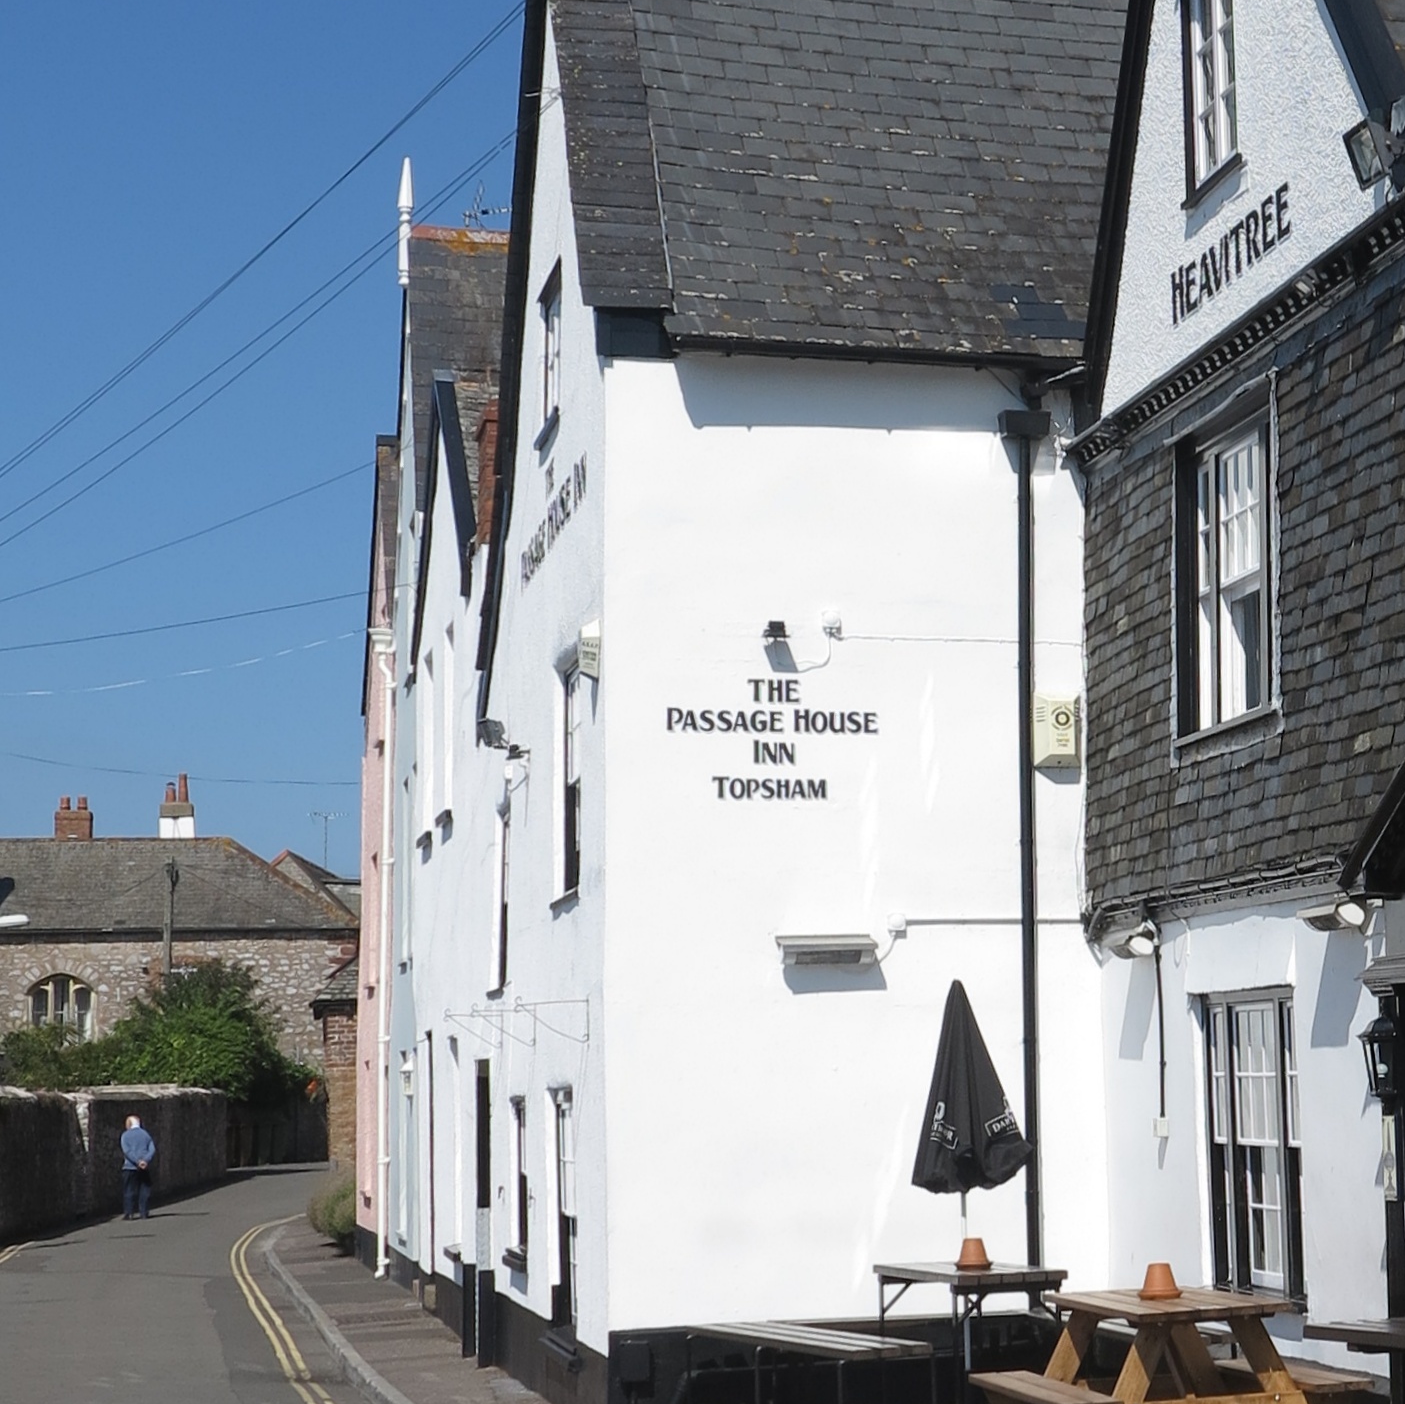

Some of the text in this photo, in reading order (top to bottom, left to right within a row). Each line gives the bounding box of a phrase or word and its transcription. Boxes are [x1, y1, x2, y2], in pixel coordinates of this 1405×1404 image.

[1170, 181, 1292, 328] HEAVITREE
[748, 679, 800, 703] THE
[666, 707, 879, 734] PASSAGE HOUSE
[753, 739, 796, 765] INN
[712, 776, 828, 800] TOPSHAM
